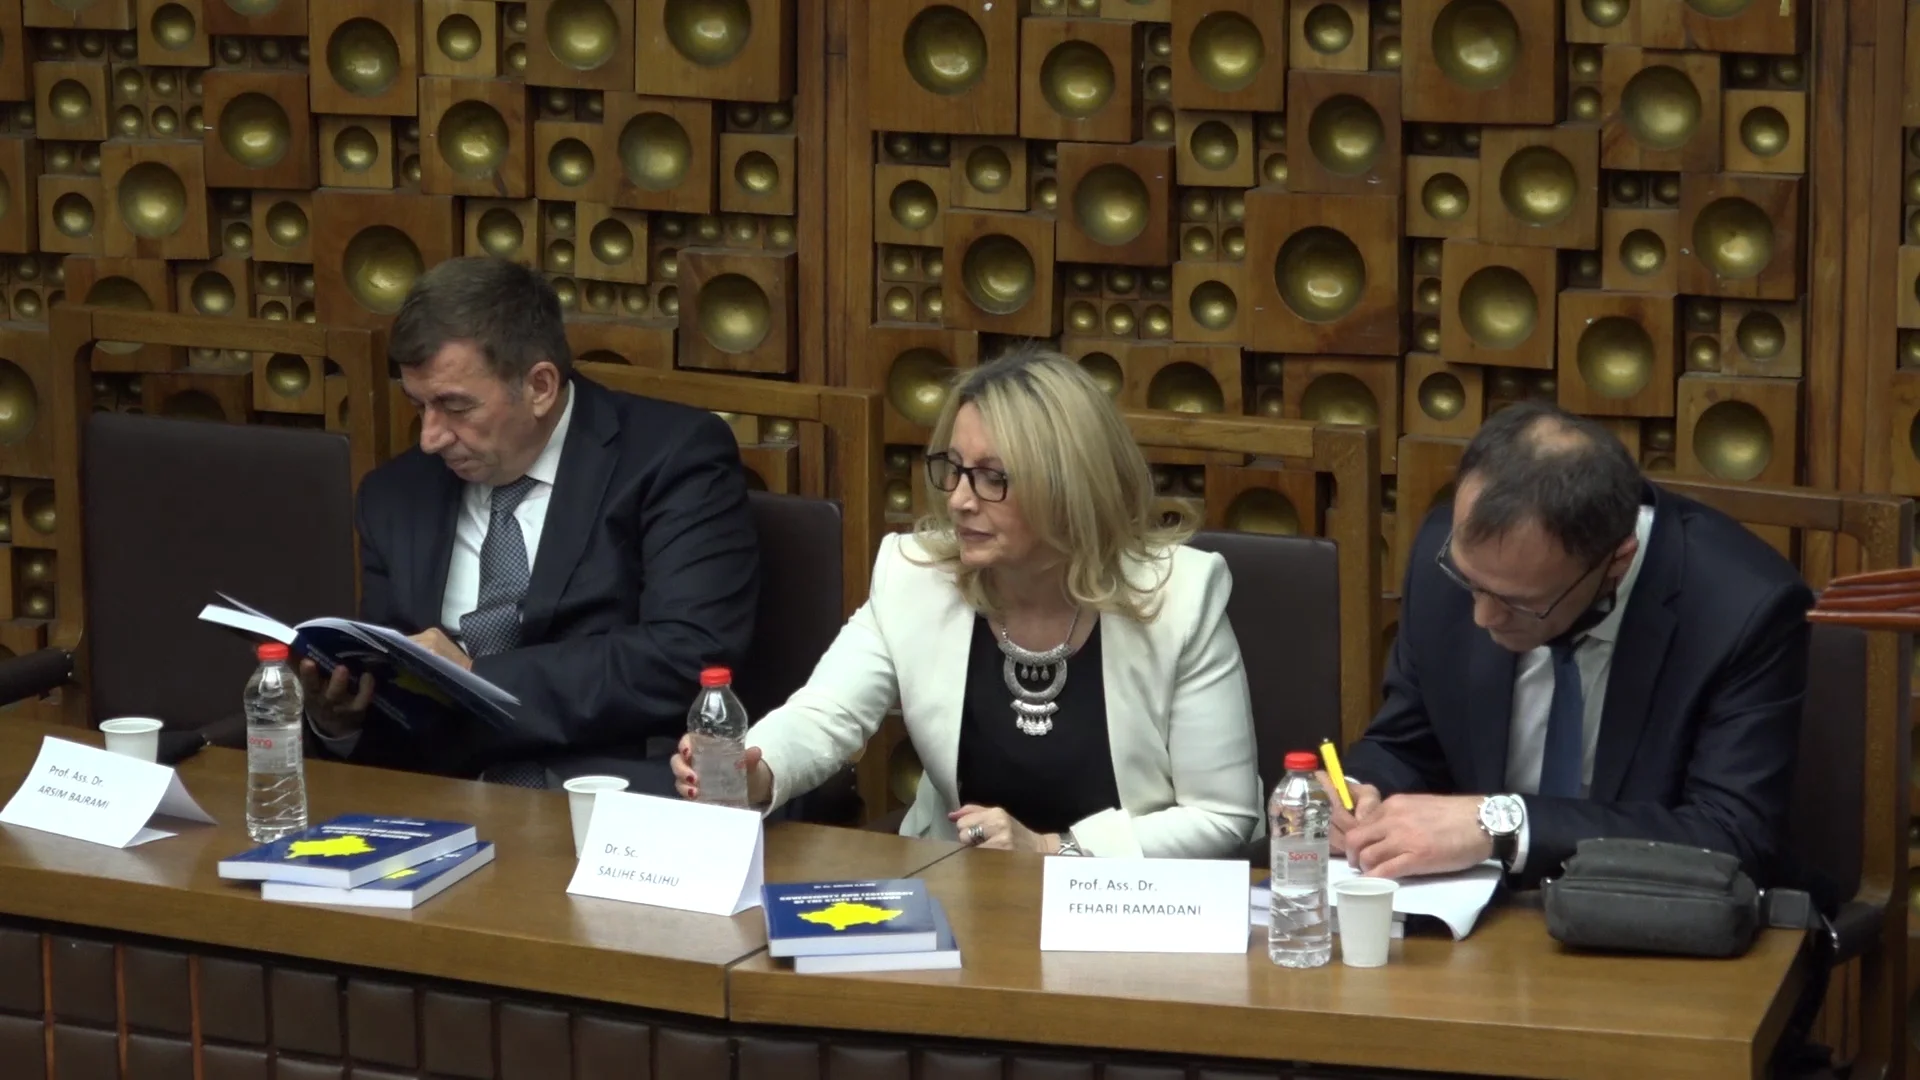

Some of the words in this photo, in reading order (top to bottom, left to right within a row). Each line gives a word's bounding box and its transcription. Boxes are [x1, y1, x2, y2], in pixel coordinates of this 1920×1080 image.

[49, 765, 70, 779] Prof.
[72, 771, 89, 784] Ass.
[91, 775, 104, 788] Dr.
[38, 785, 68, 799] ARSIM
[604, 843, 620, 855] Dr.
[624, 846, 638, 858] Sc.
[1288, 851, 1318, 862] Spring
[597, 866, 636, 880] SALIHE
[638, 871, 680, 887] SALIHU
[1069, 879, 1102, 891] Prof.
[1106, 880, 1133, 891] Ass.
[1138, 880, 1158, 891] Dr.
[1069, 903, 1118, 914] FEHARI
[1122, 904, 1201, 916] RAMADANI
